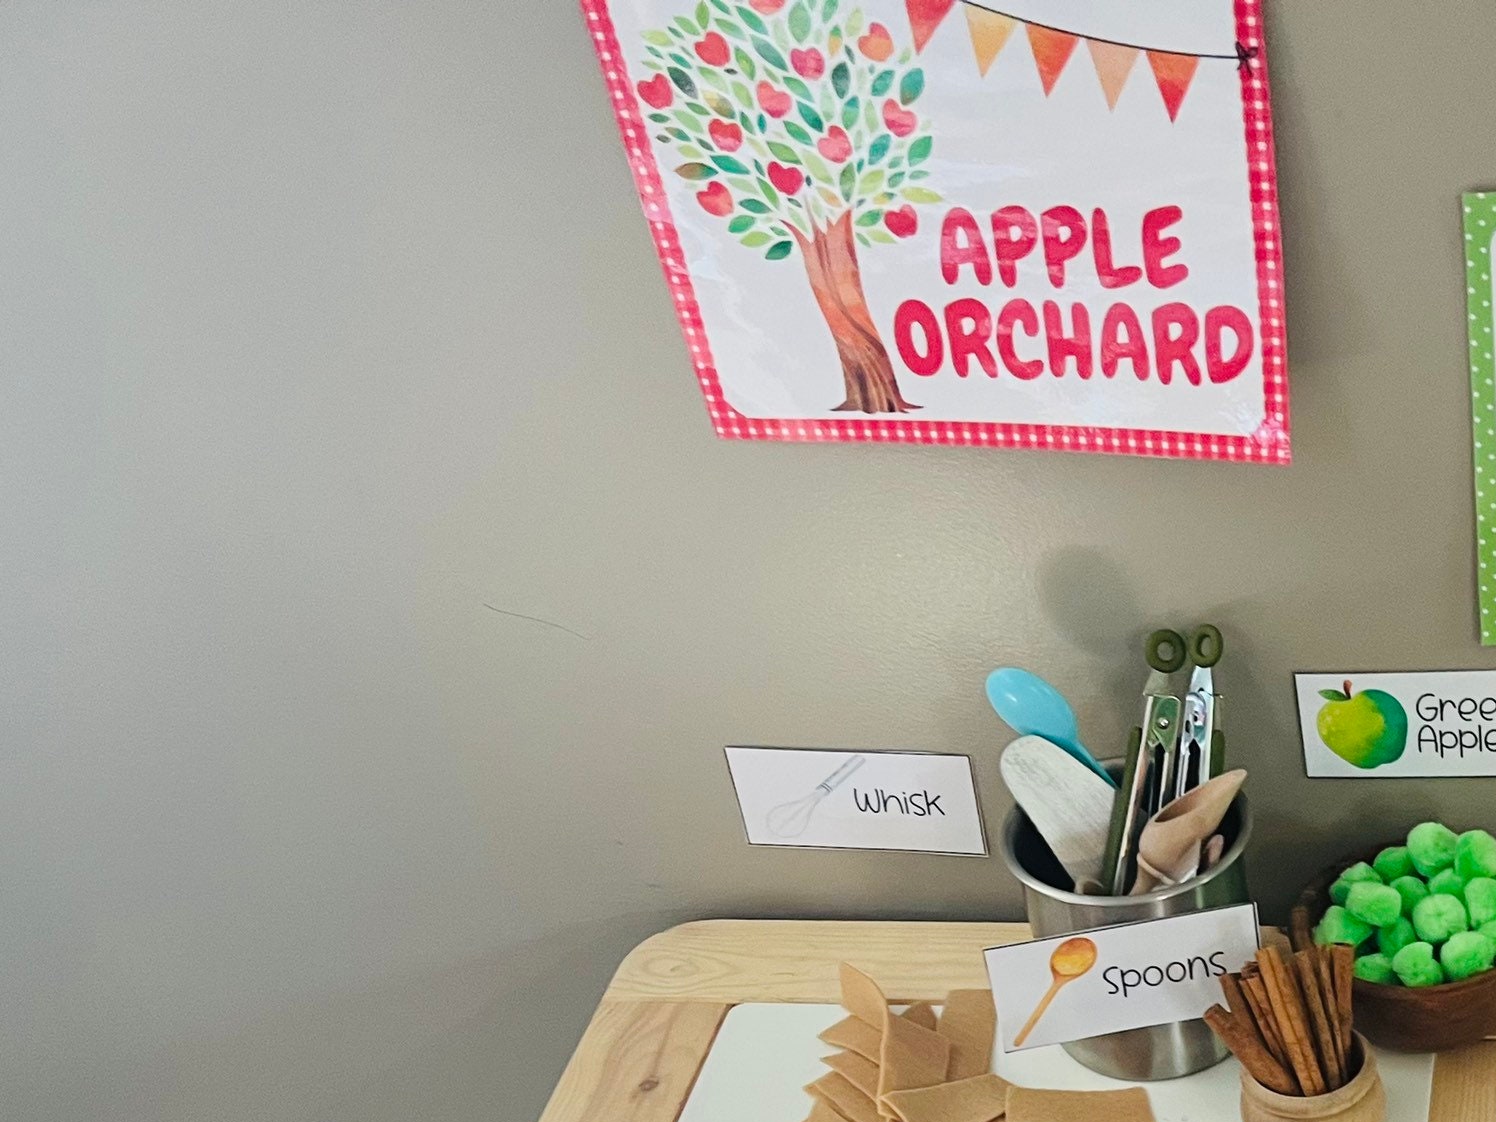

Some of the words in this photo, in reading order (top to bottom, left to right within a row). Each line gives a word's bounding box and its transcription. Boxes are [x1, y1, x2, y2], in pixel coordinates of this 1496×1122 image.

[941, 206, 1188, 289] APPLE
[894, 298, 1253, 386] ORCHARD
[854, 788, 945, 816] Whisk
[1102, 951, 1227, 998] Spoons
